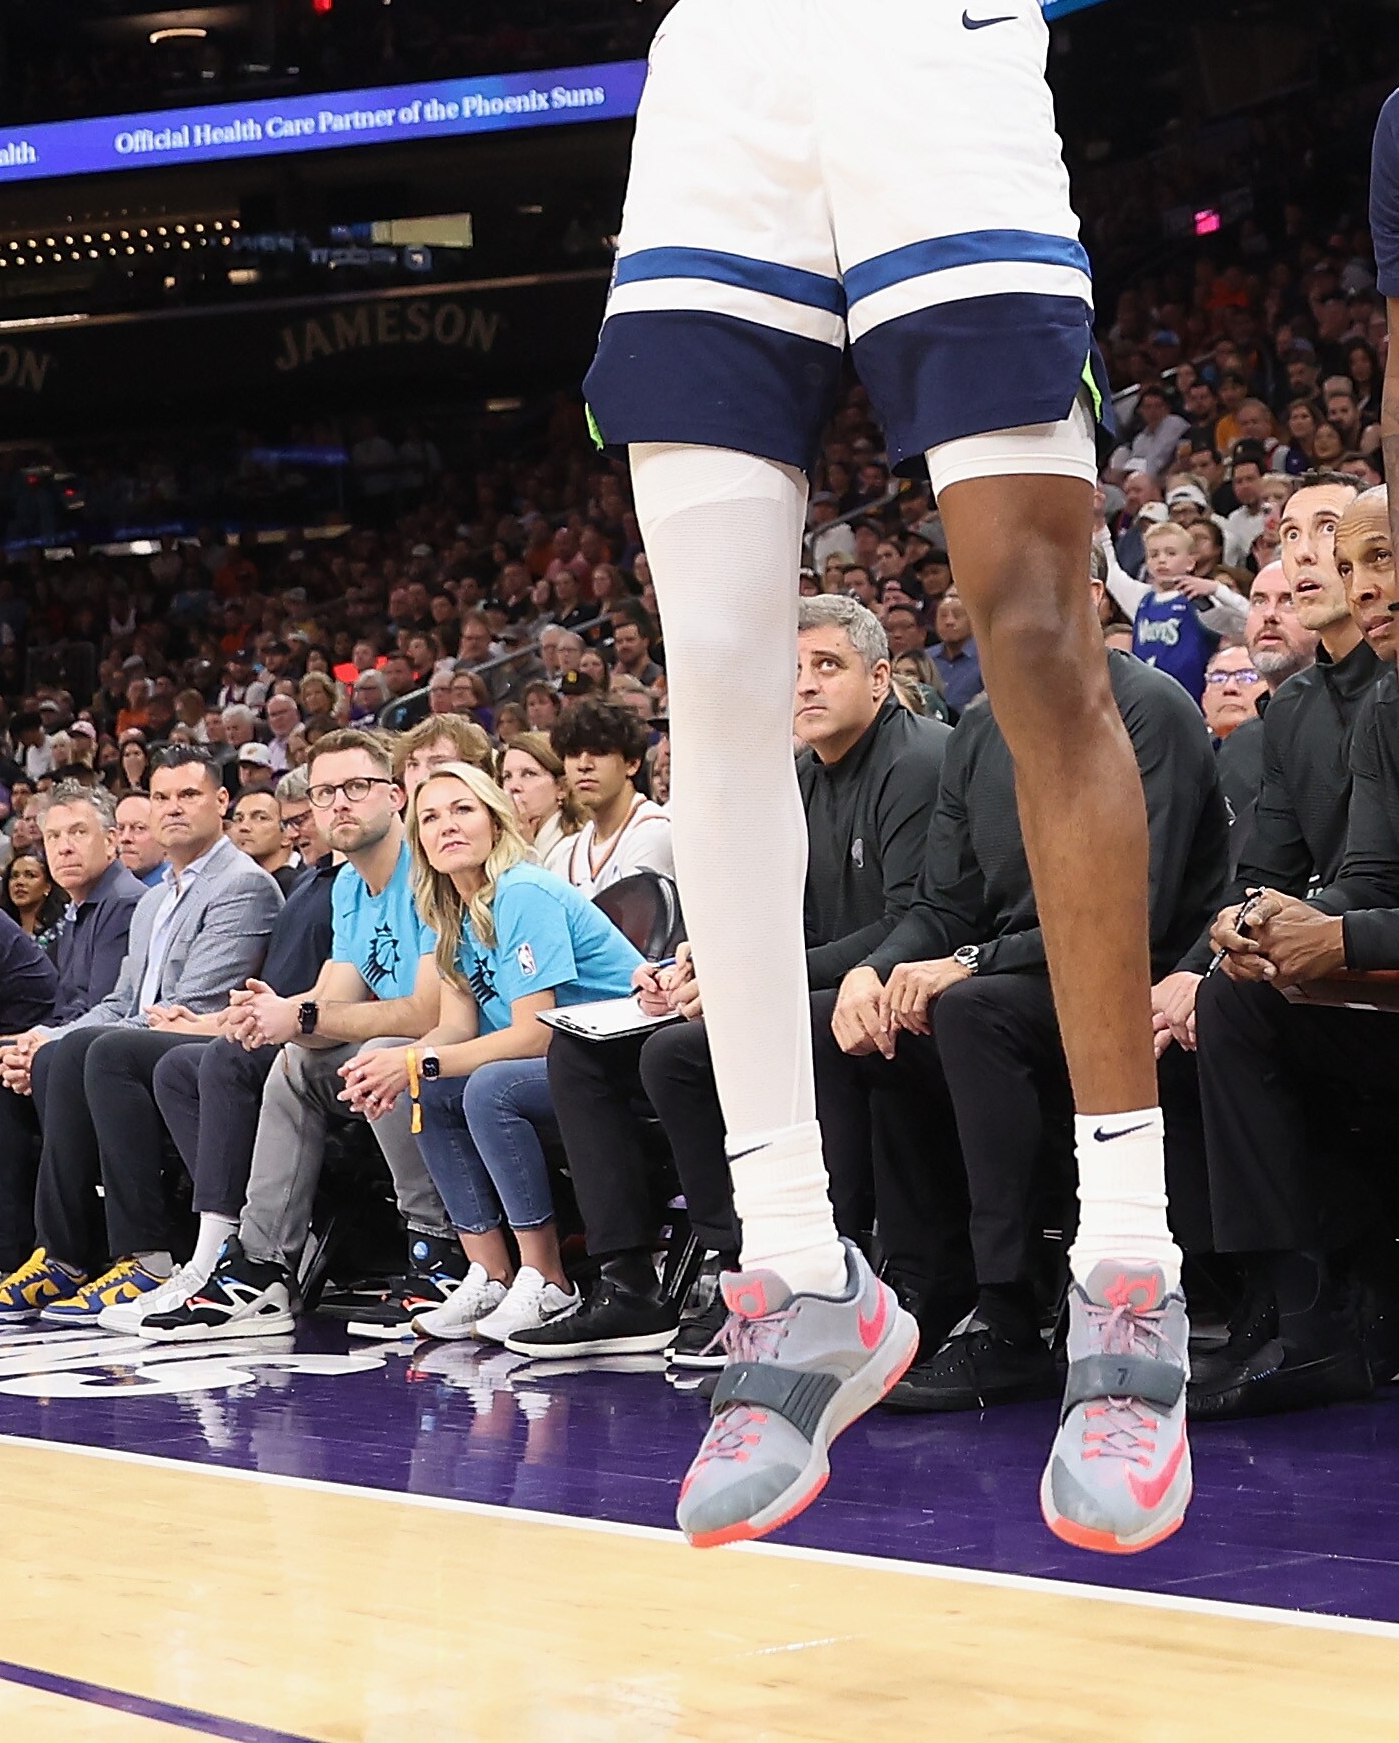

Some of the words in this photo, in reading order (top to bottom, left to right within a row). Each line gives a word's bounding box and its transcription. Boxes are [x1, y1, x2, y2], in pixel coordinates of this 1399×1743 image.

[114, 124, 190, 155] Official
[193, 118, 262, 147] Health
[265, 114, 315, 139] Care
[318, 103, 395, 134] Partner
[398, 100, 420, 125] of
[420, 98, 460, 122] the
[461, 89, 551, 119] Phoenix
[550, 85, 606, 111] Suns
[274, 301, 501, 372] JAMESON
